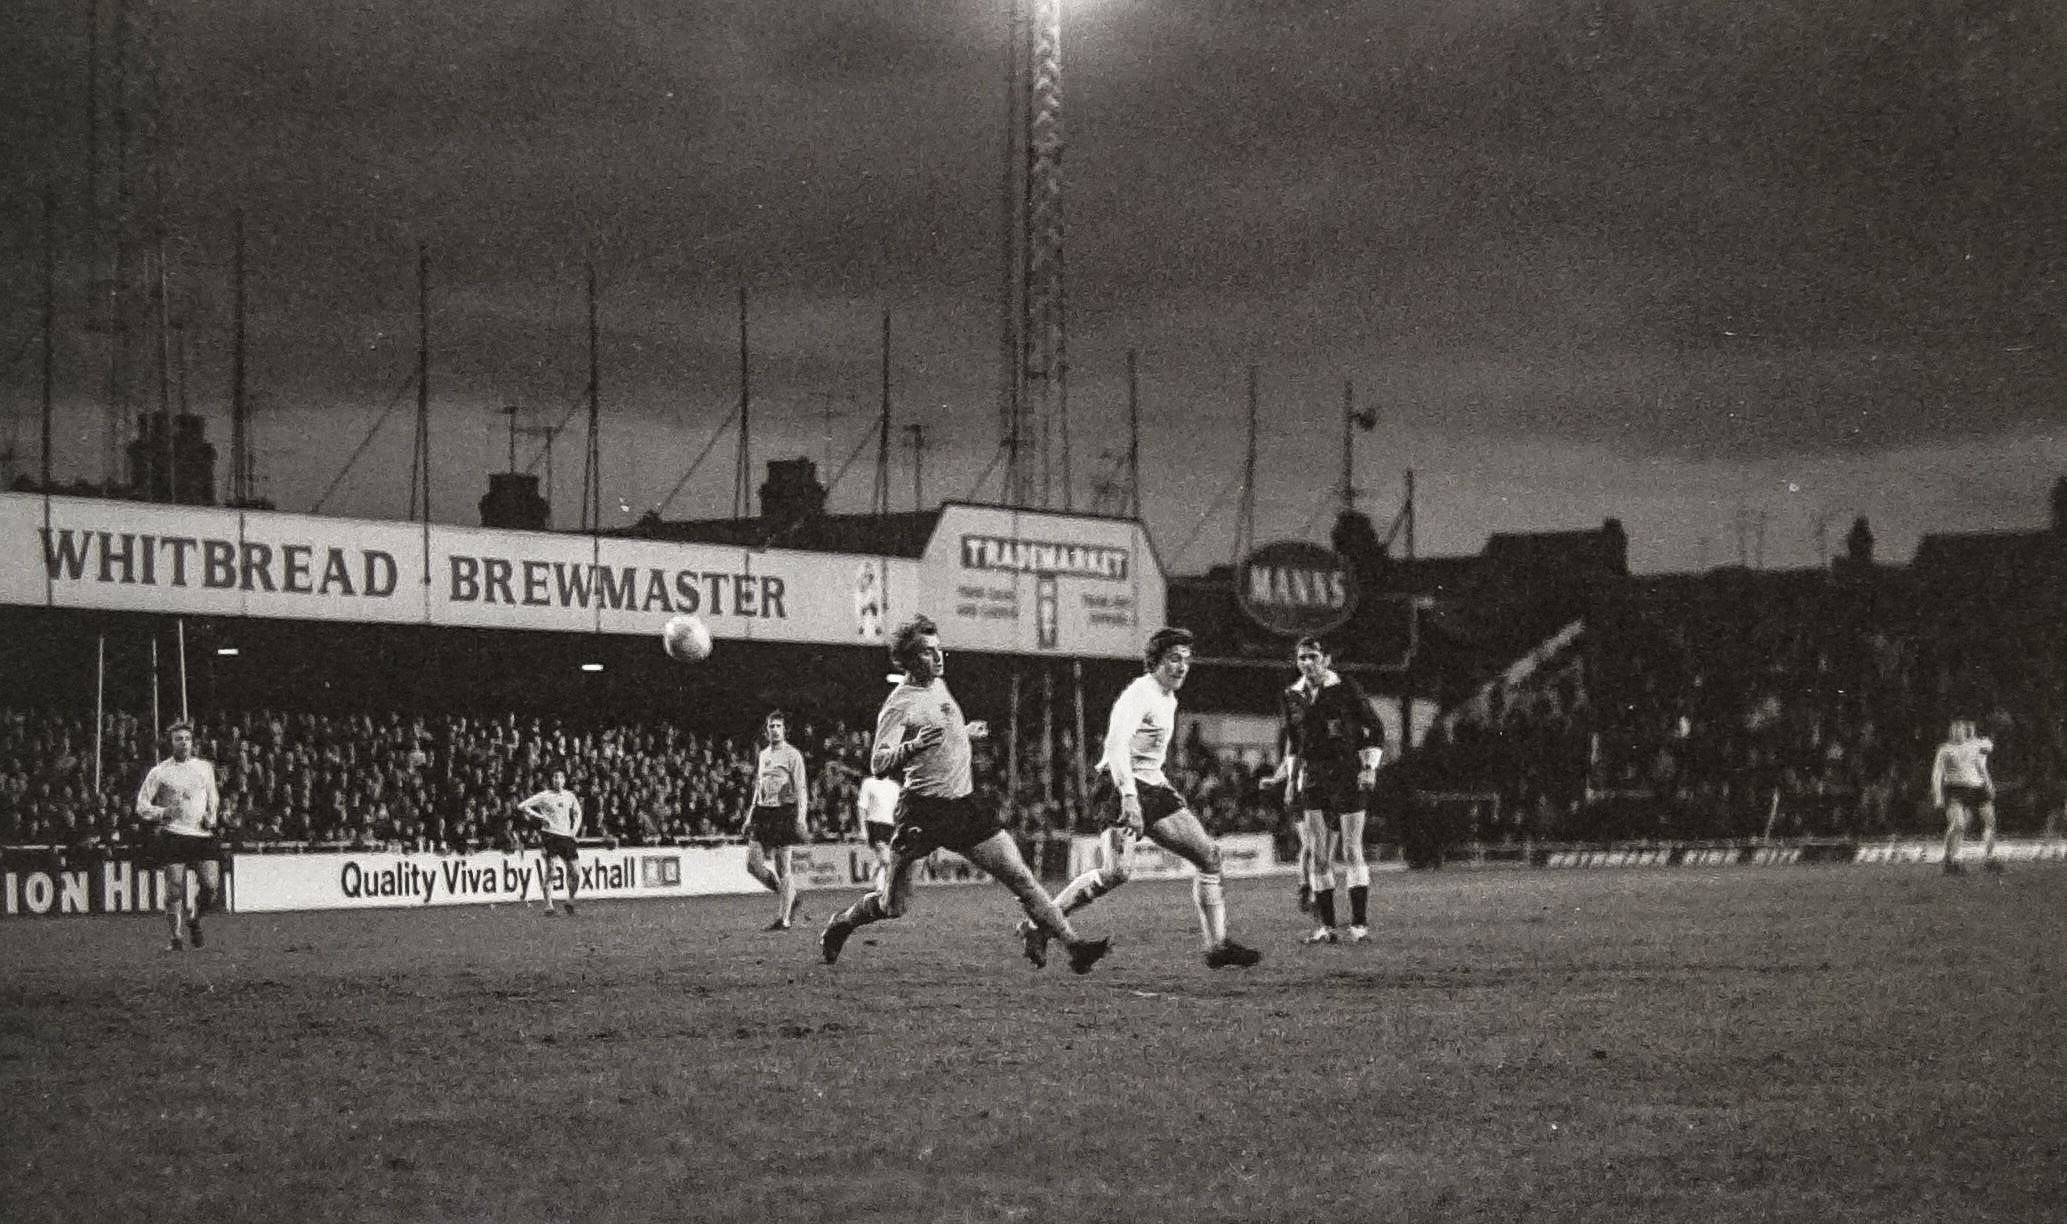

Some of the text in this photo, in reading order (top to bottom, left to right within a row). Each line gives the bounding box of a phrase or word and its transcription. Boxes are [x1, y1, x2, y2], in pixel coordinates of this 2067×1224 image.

[39, 527, 787, 619] WHITBREAD BREWMASTER
[340, 855, 636, 903] Quality Viva by Vaxhall
